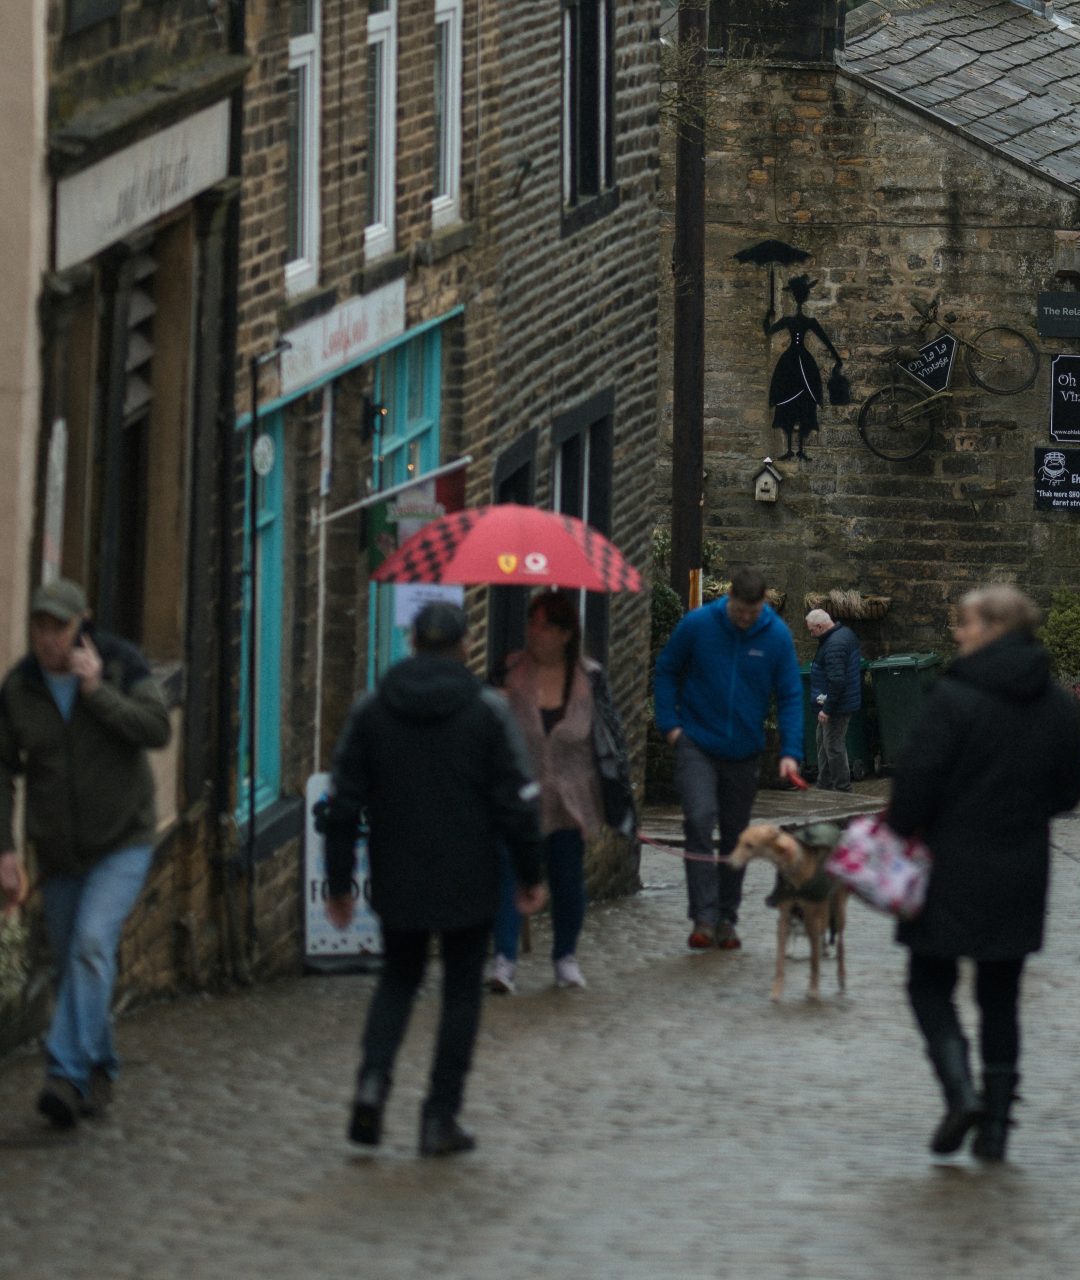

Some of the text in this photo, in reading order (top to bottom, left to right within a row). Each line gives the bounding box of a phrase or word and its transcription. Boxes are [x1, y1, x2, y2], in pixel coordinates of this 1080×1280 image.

[1043, 307, 1060, 315] The
[922, 351, 935, 362] La
[934, 343, 947, 355] La
[1058, 372, 1077, 387] Oh
[1071, 473, 1080, 484] Eh
